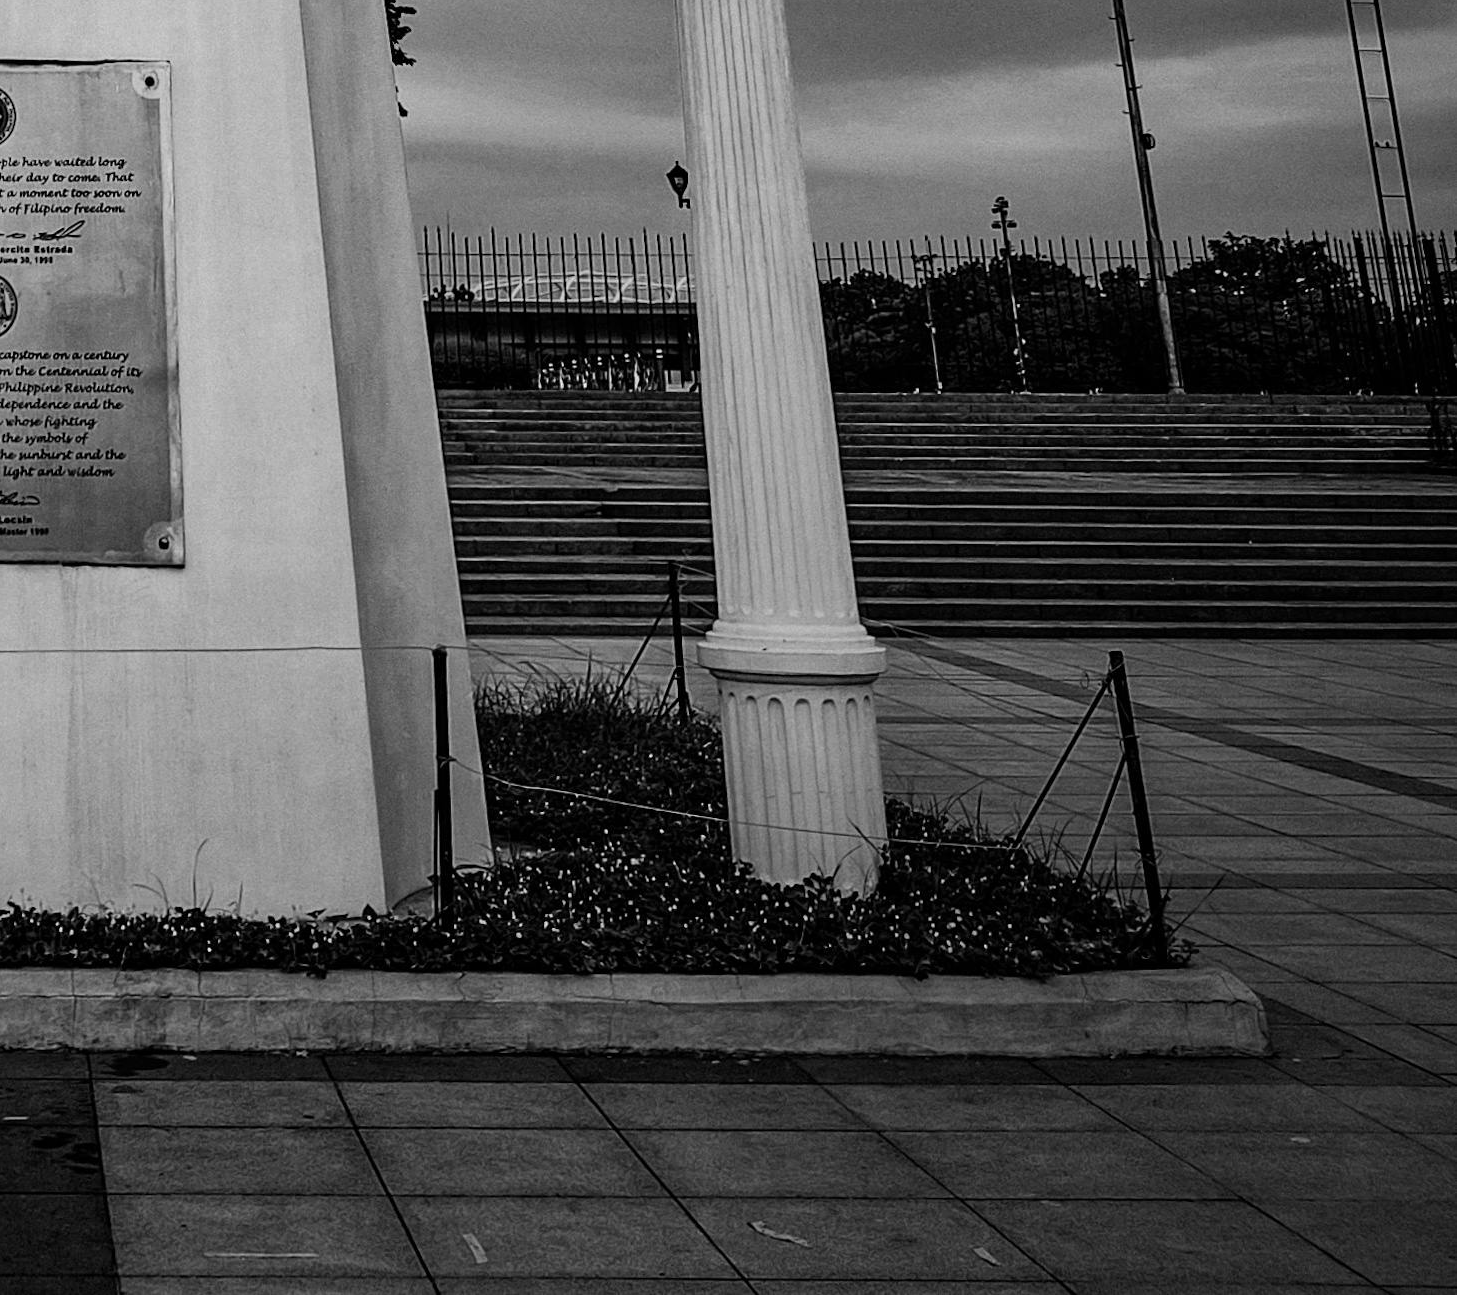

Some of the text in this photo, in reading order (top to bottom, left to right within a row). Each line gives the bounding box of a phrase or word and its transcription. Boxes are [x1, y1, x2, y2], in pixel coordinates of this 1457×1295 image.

[22, 156, 52, 168] have
[54, 155, 96, 168] waited
[98, 155, 127, 170] long
[26, 171, 49, 186] day
[52, 172, 66, 183] to
[105, 171, 134, 183] That
[7, 189, 17, 199] a
[20, 188, 69, 199] moment
[71, 188, 92, 199] too
[93, 189, 122, 199] soon
[124, 189, 141, 199] on
[9, 201, 22, 216] of
[24, 201, 72, 218] Filipino
[34, 244, 73, 255] Estrada
[0, 349, 51, 364] capstone
[53, 352, 70, 361] on
[72, 352, 82, 361] a
[84, 350, 129, 364] century
[16, 364, 36, 377] the
[39, 365, 108, 377] Centennial
[111, 365, 124, 379] of
[127, 366, 143, 379] its
[65, 381, 134, 395] Revolution,
[73, 397, 100, 410] and
[103, 397, 124, 410] the
[6, 414, 42, 428] whose
[44, 414, 97, 431] fighting
[2, 431, 23, 444] the
[25, 431, 73, 448] symbols
[75, 431, 88, 446] of
[19, 448, 73, 462] sunburst
[76, 448, 103, 461] and
[105, 448, 126, 461] the
[3, 465, 36, 481] light
[38, 465, 65, 478] and
[68, 465, 115, 478] wisdom
